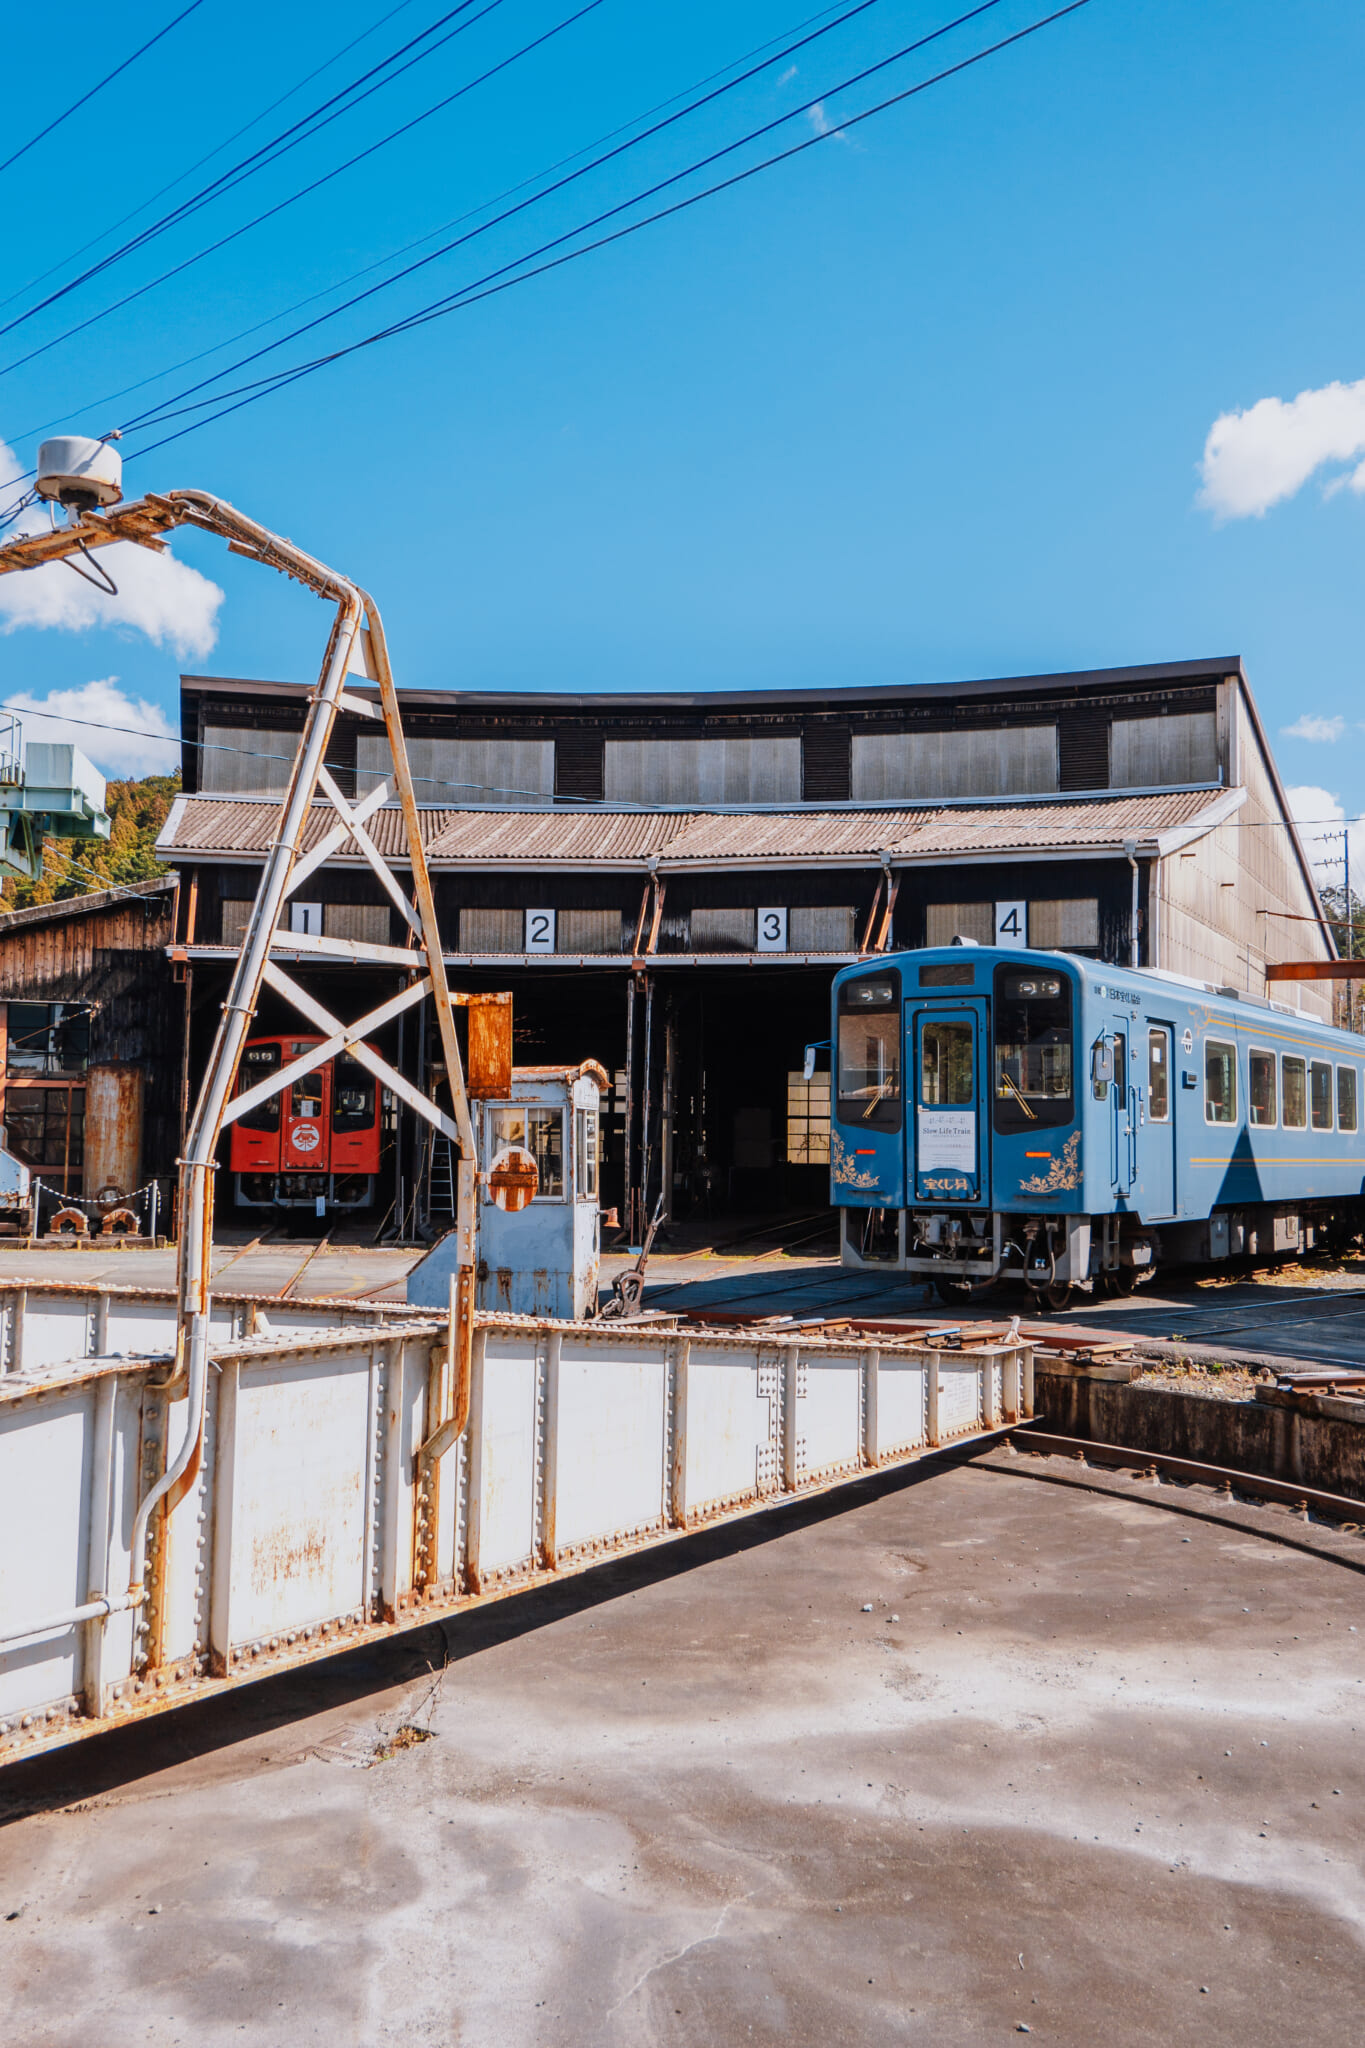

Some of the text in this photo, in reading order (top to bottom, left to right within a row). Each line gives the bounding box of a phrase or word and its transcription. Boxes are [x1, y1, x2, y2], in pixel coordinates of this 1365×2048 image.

[302, 909, 309, 934] 1
[531, 915, 549, 943] 2
[763, 913, 781, 941] 3
[999, 908, 1022, 937] 4
[922, 1127, 971, 1135] Slow Life Train
[923, 1178, 968, 1190] 宝くじ号
